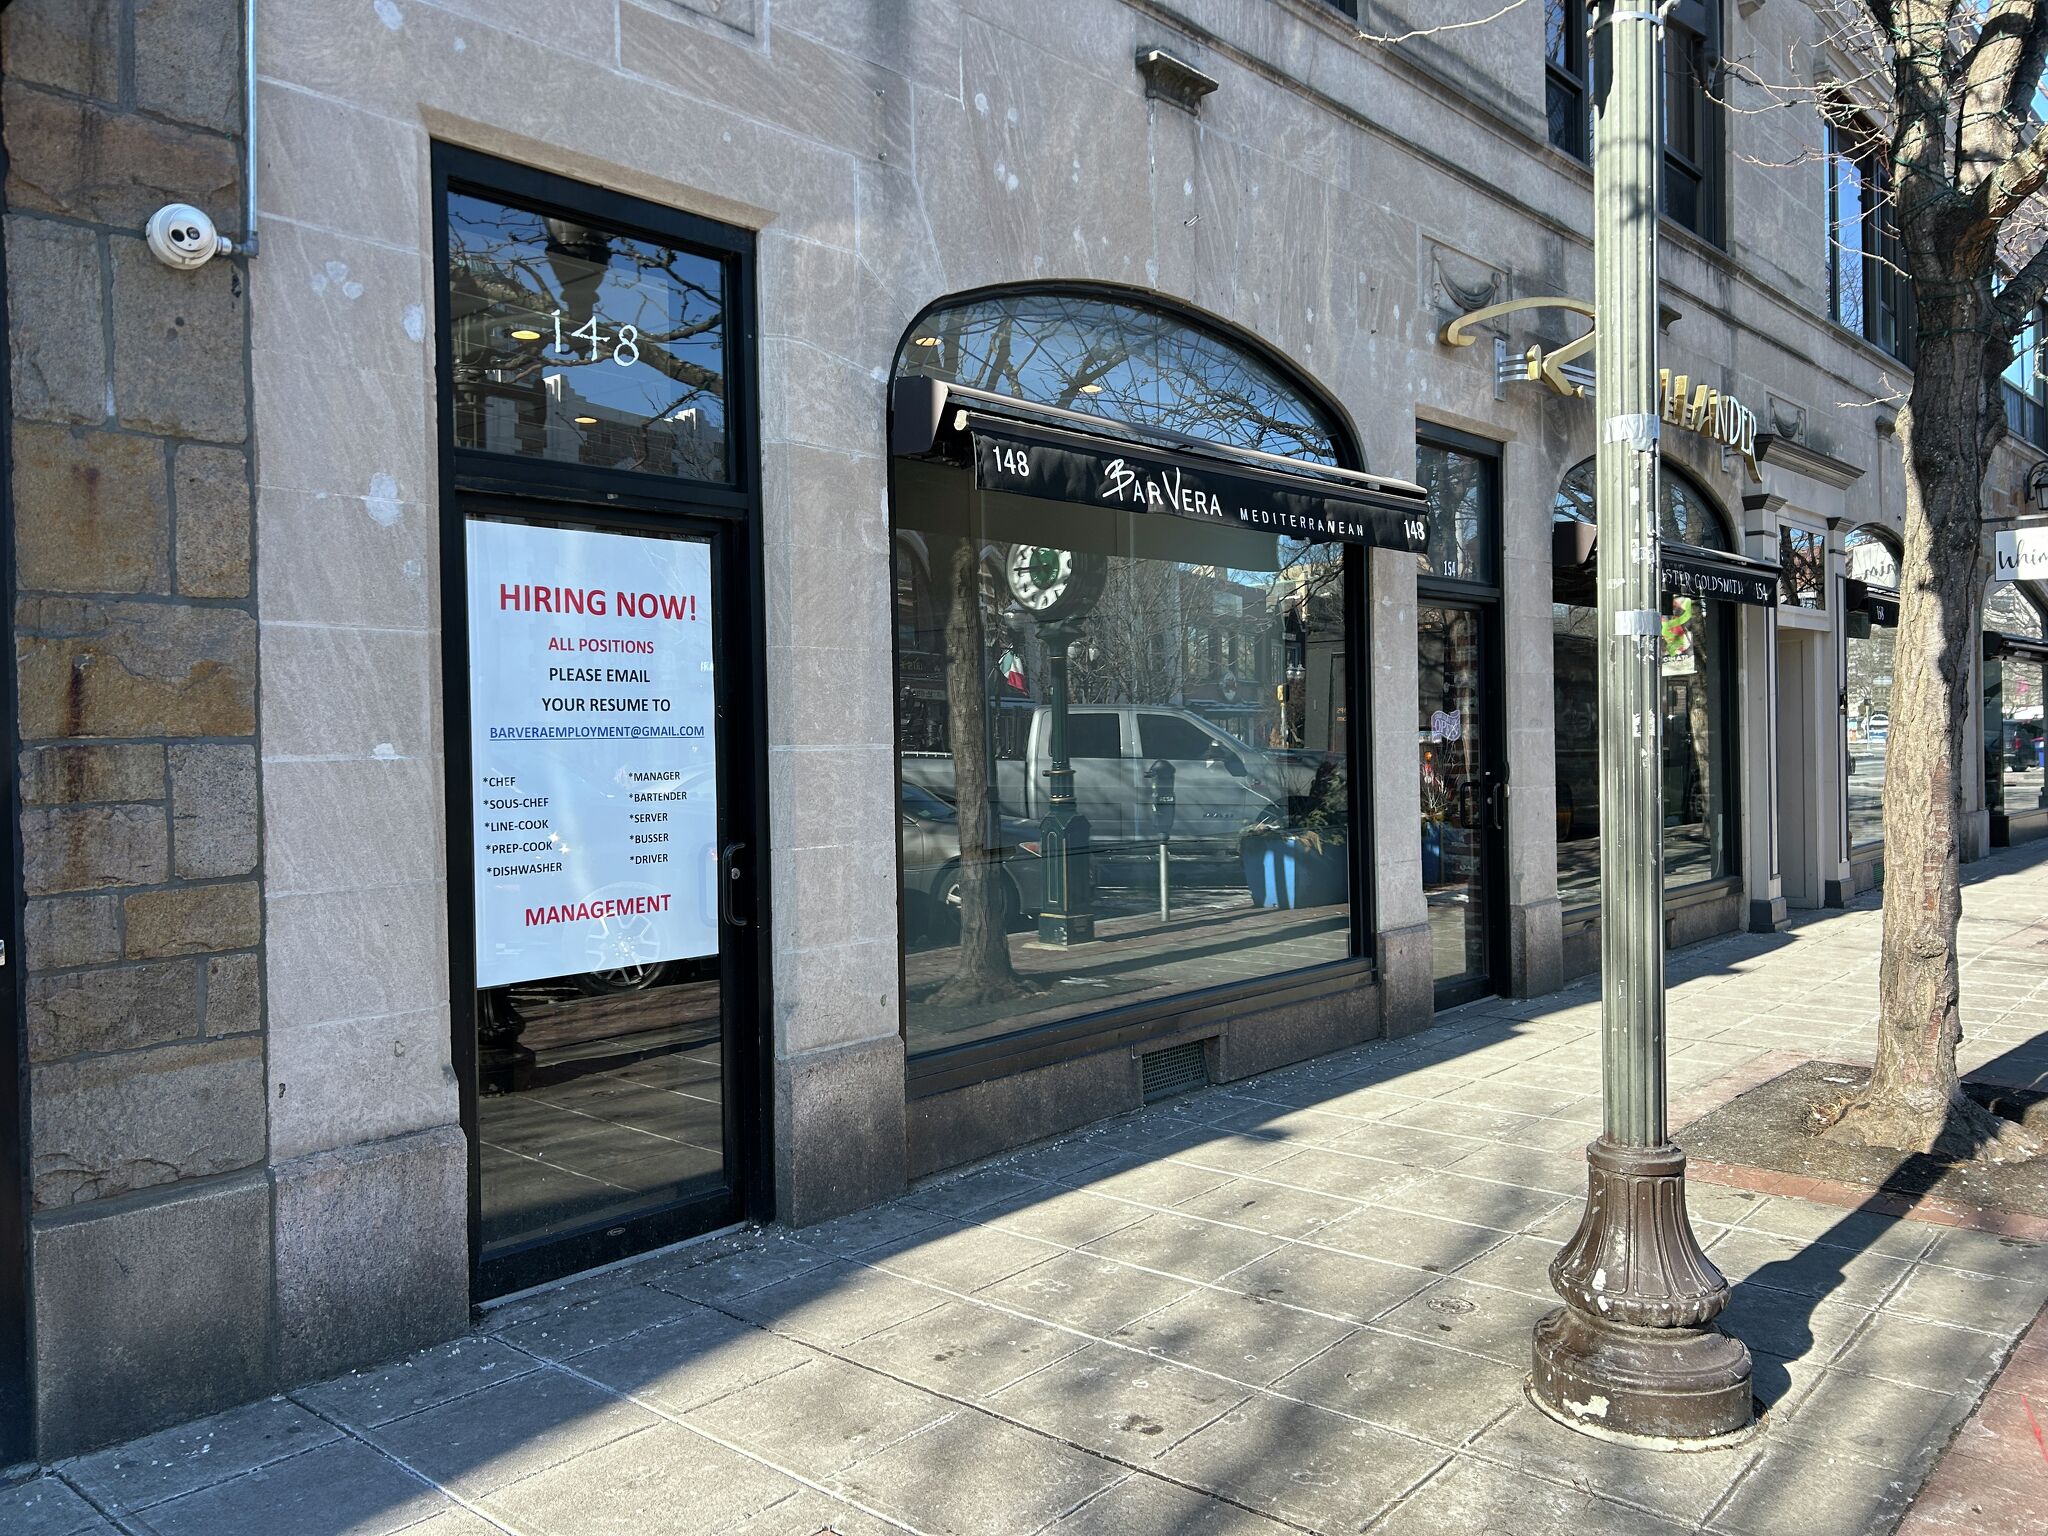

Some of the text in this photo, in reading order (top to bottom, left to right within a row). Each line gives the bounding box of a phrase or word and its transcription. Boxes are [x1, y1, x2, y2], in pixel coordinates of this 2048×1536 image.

[551, 309, 640, 367] 148
[992, 445, 1030, 477] 148
[1239, 507, 1364, 537] MEDITERRANEAN
[1404, 519, 1426, 540] 148
[1443, 560, 1456, 577] 154
[1661, 567, 1768, 600] STER GOLDSMITH 154
[500, 583, 696, 621] HIRING NOW!
[548, 637, 654, 654] ALL POSITIONS
[549, 667, 651, 683] PLEASE EMAIL
[542, 697, 671, 712] YOUR RESUME TO
[490, 725, 705, 741] BARVERAEMPLOYMENT@GMAIL.COM
[525, 894, 672, 927] MANAGEMENT
